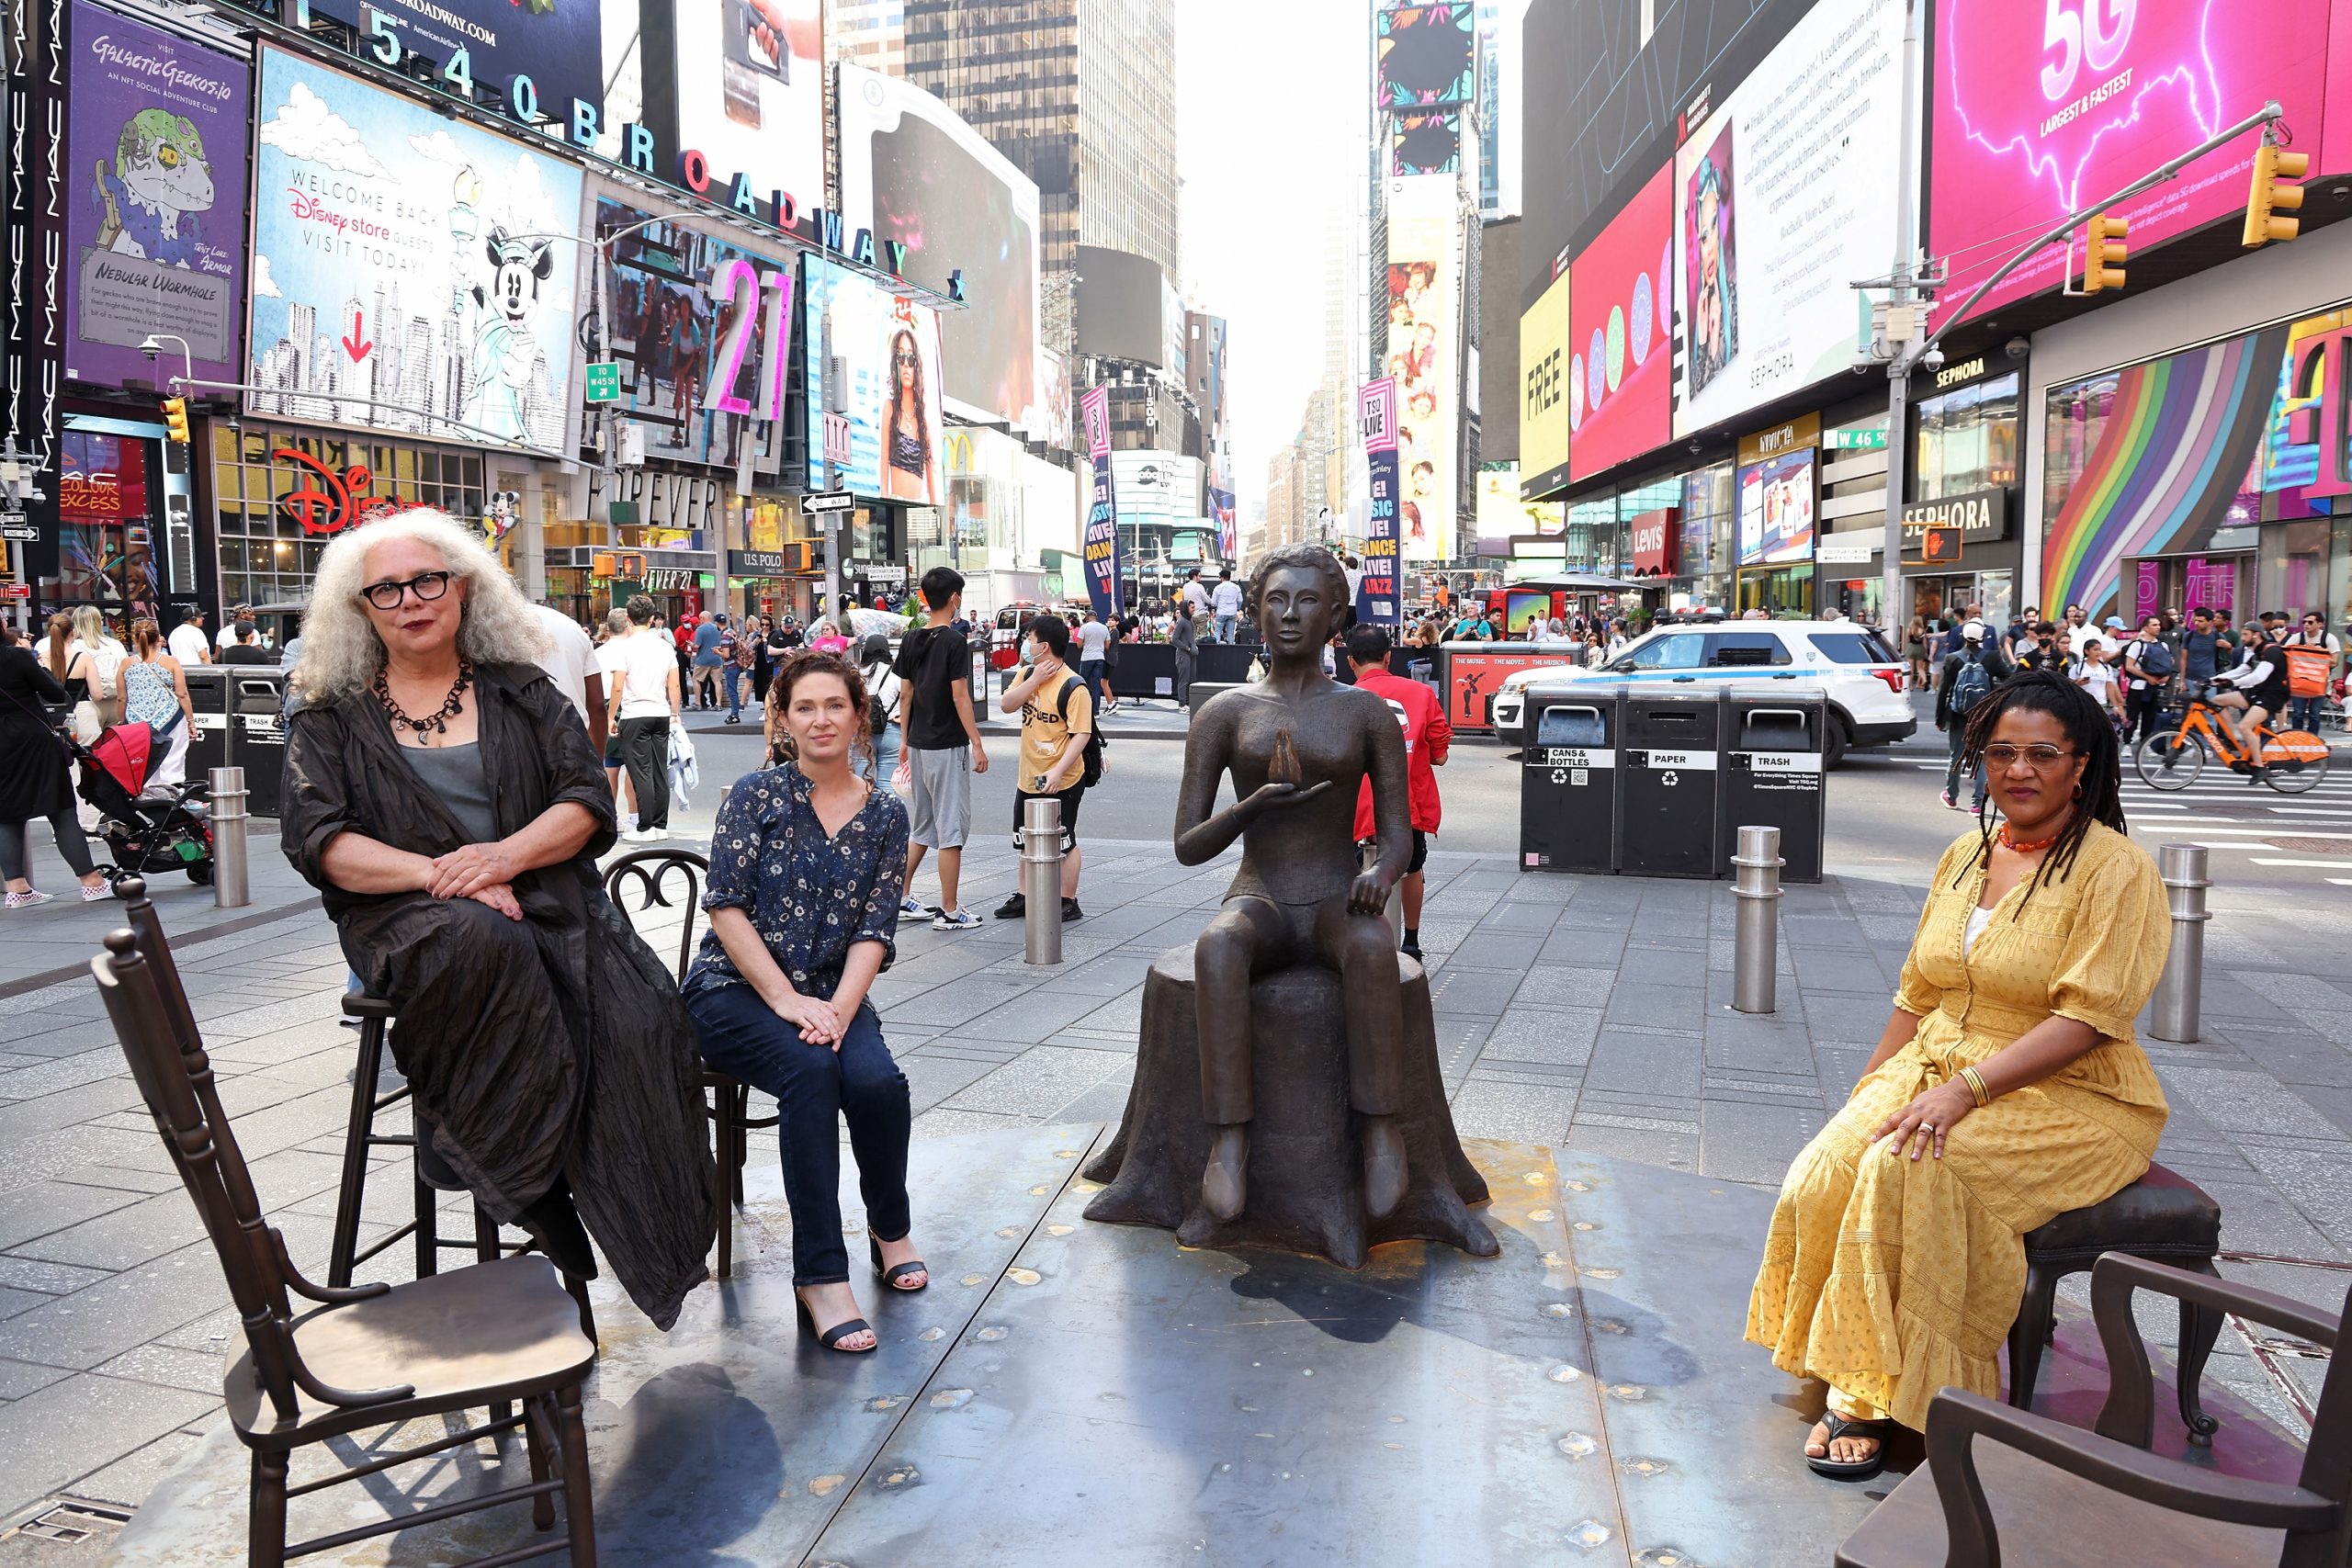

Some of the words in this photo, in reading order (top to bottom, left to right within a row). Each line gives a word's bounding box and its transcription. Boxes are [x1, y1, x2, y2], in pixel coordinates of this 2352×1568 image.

[413, 24, 440, 42] American
[157, 44, 175, 55] VISIT
[2041, 0, 2138, 102] 5G
[107, 72, 120, 81] AN
[121, 75, 134, 85] NFT
[136, 81, 161, 96] SOCIAL
[163, 90, 200, 108] ADVENTURE
[202, 103, 218, 114] CLUB
[2040, 99, 2082, 139] LARGEST
[2081, 96, 2089, 114] &
[2089, 67, 2133, 109] FASTEST
[571, 96, 908, 275] BROADWAY
[292, 168, 383, 212] WELCOME
[397, 202, 439, 228] BACK
[351, 218, 390, 241] store
[394, 232, 435, 254] GUESTS
[303, 230, 351, 257] VISIT
[363, 245, 425, 276] TODAY!
[200, 254, 232, 275] ARMOR
[96, 263, 149, 288] NEBULAR
[153, 274, 217, 301] WORMHOLE
[102, 288, 121, 299] geckos
[123, 293, 134, 301] who
[146, 297, 162, 306] brave
[163, 301, 181, 312] enough
[105, 300, 120, 310] might
[121, 303, 130, 311] this
[707, 259, 792, 423] 21
[598, 367, 607, 376] TO
[1750, 352, 1794, 389] SEPHORA
[1936, 357, 1984, 389] SEPHORA
[597, 378, 607, 386] 45
[607, 378, 616, 386] St
[1528, 347, 1561, 422] FREE
[1146, 386, 1154, 428] 1500
[1364, 413, 1383, 437] LIVE
[1839, 435, 1851, 446] W
[1855, 433, 1871, 446] 46
[1138, 468, 1159, 480] abc
[808, 499, 824, 509] ONE
[831, 497, 847, 506] WAY
[1905, 497, 1991, 538] SEPHORA
[743, 553, 759, 567] U.S.
[759, 554, 782, 567] POLO
[679, 570, 693, 591] 21
[1364, 578, 1393, 594] JAZZ
[1550, 758, 1589, 767] BOTTLES
[1552, 749, 1577, 757] CANS
[1578, 749, 1587, 757] &
[1655, 755, 1687, 764] PAPER
[1758, 757, 1791, 766] TRASH
